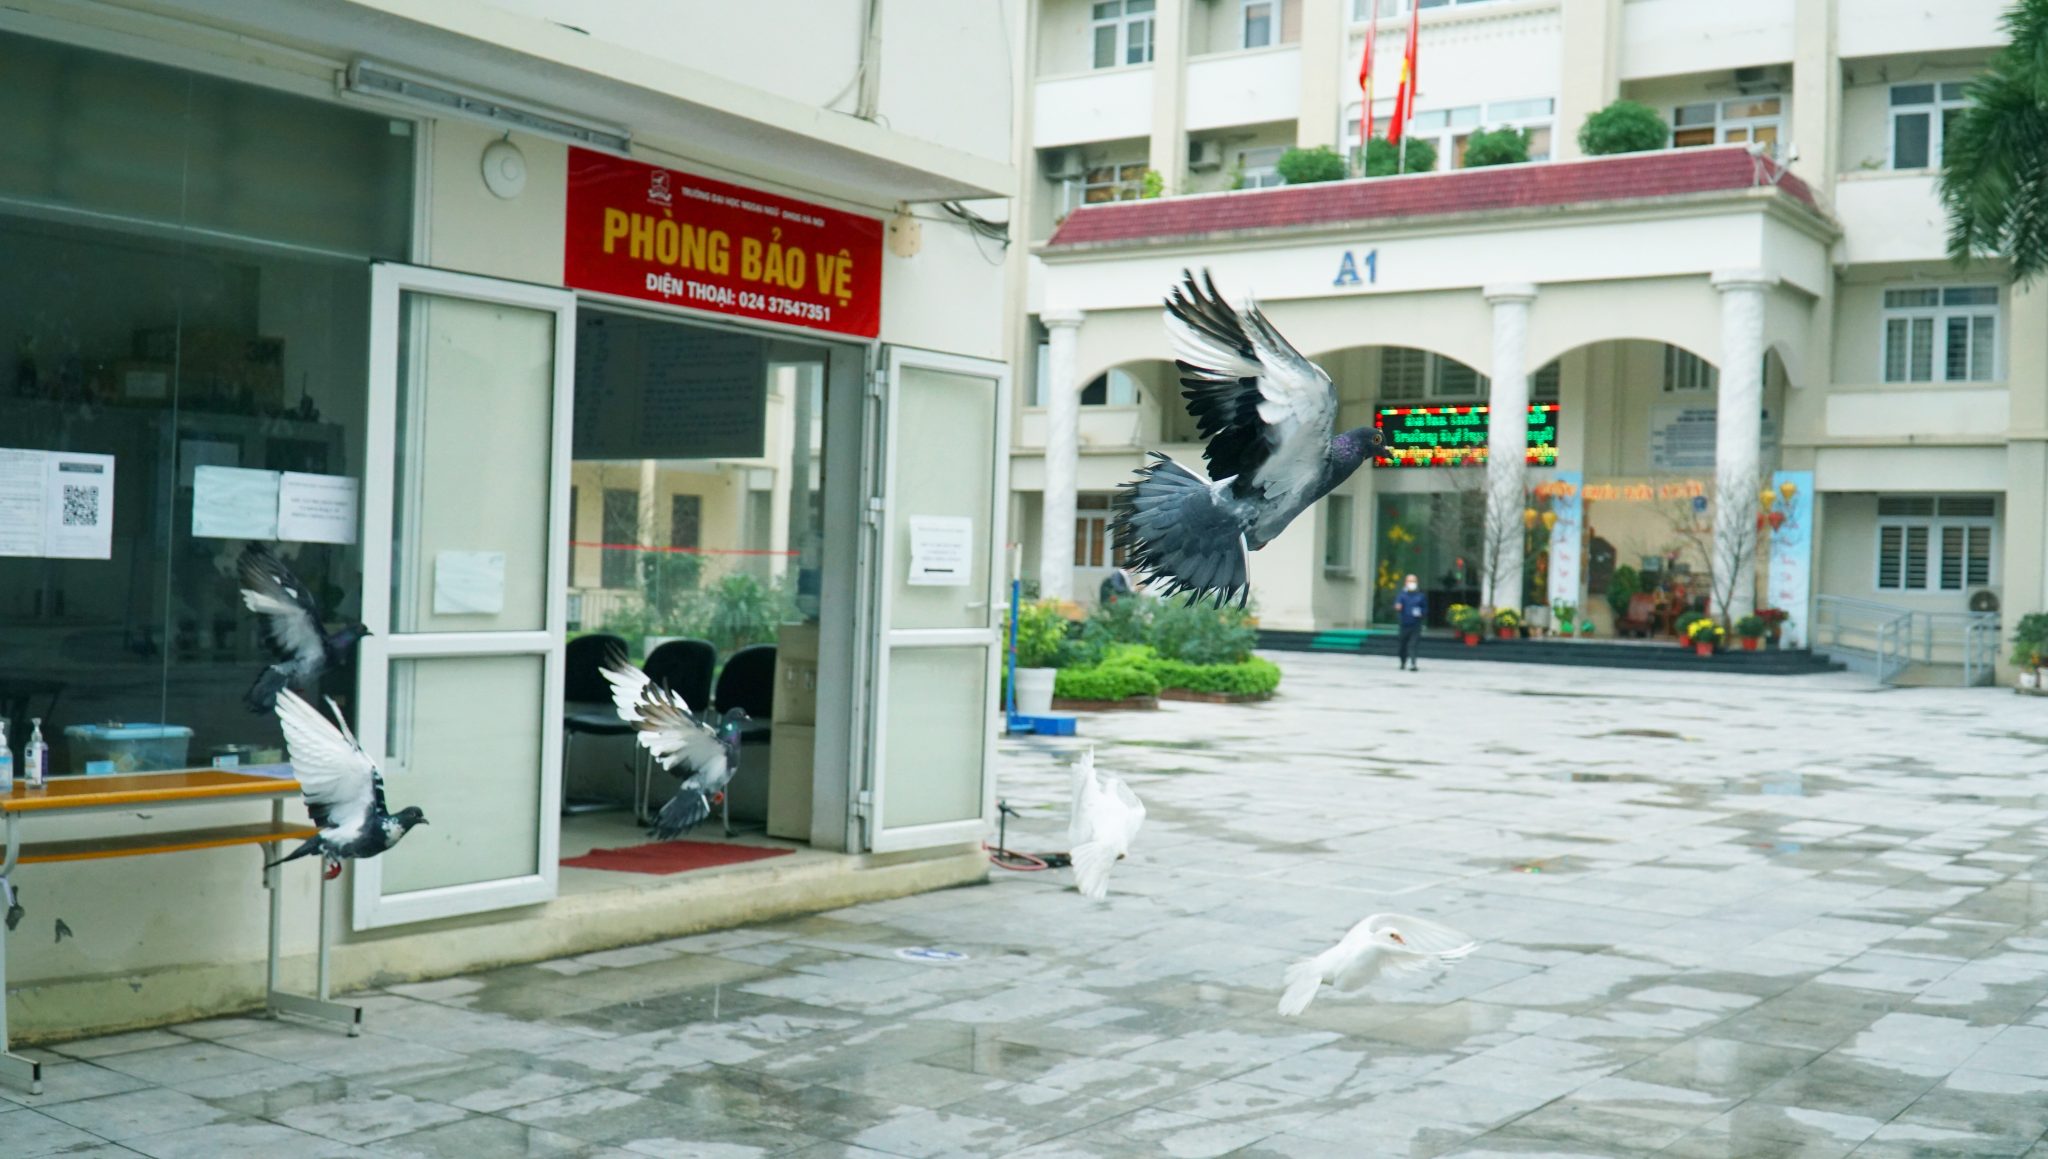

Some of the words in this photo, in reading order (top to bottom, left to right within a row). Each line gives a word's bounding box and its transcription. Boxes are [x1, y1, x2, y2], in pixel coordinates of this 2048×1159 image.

[603, 208, 730, 276] PHÒNG
[741, 226, 806, 290] BẢO
[816, 248, 853, 307] VỆ
[1333, 249, 1378, 286] A1
[645, 272, 684, 299] ĐIỆN
[686, 280, 737, 308] THOẠI:
[738, 291, 766, 311] 024
[767, 296, 832, 322] 37547351
